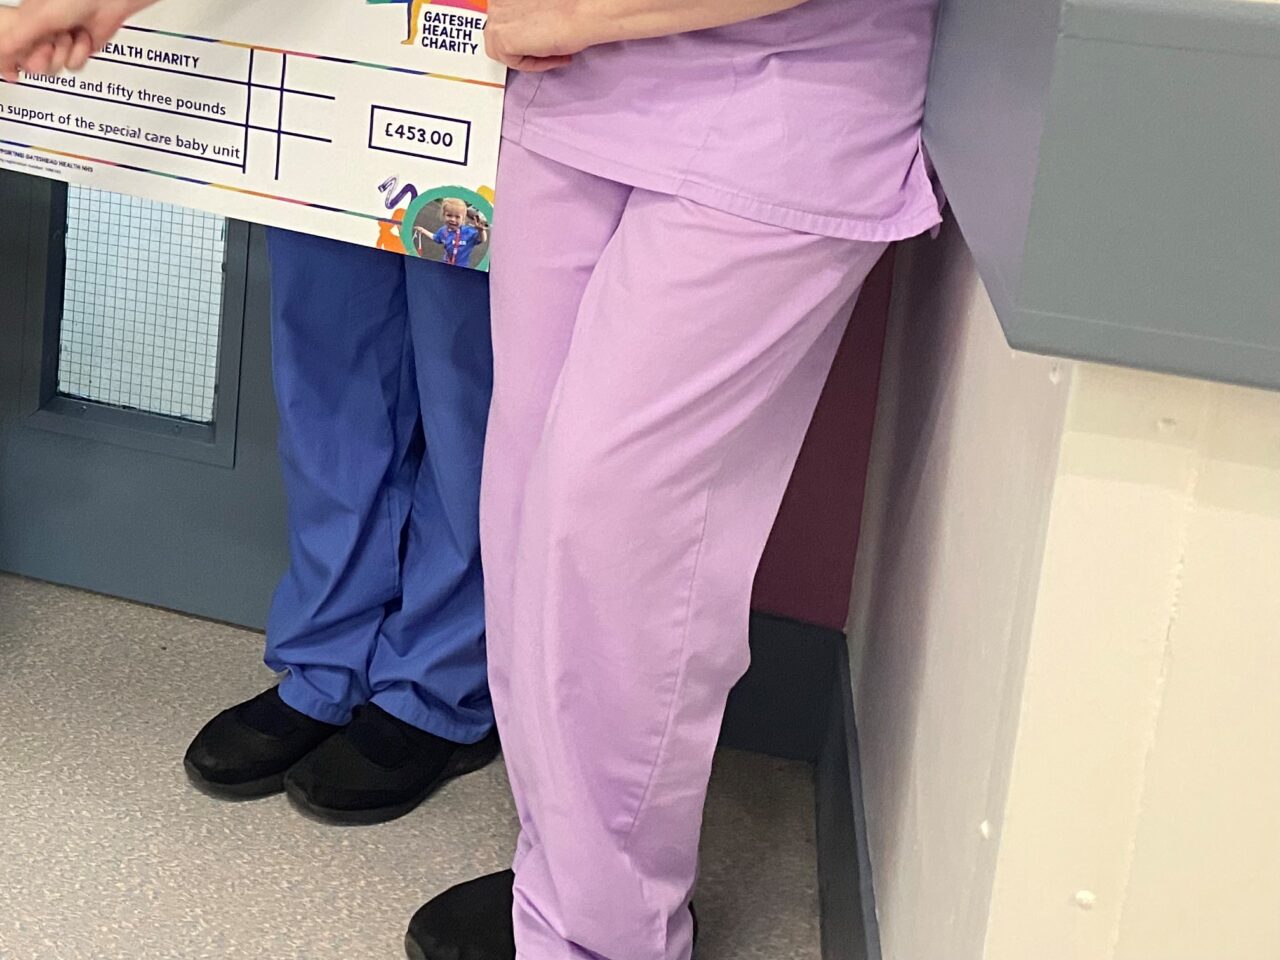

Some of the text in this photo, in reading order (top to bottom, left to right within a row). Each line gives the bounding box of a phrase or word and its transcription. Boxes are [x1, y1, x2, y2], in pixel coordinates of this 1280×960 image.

[424, 11, 487, 31] GATESHE
[423, 24, 472, 41] HEALTH
[422, 37, 478, 55] CHARITY
[147, 47, 199, 68] CHARITY
[80, 80, 103, 93] and
[107, 84, 134, 100] fifty
[138, 90, 172, 106] three
[176, 97, 226, 115] pounds
[7, 105, 54, 122] support
[58, 114, 70, 125] of
[76, 116, 95, 130] the
[98, 122, 141, 139] special
[145, 132, 171, 145] care
[176, 135, 208, 154] baby
[213, 146, 240, 159] unit
[385, 122, 453, 147] £453.00
